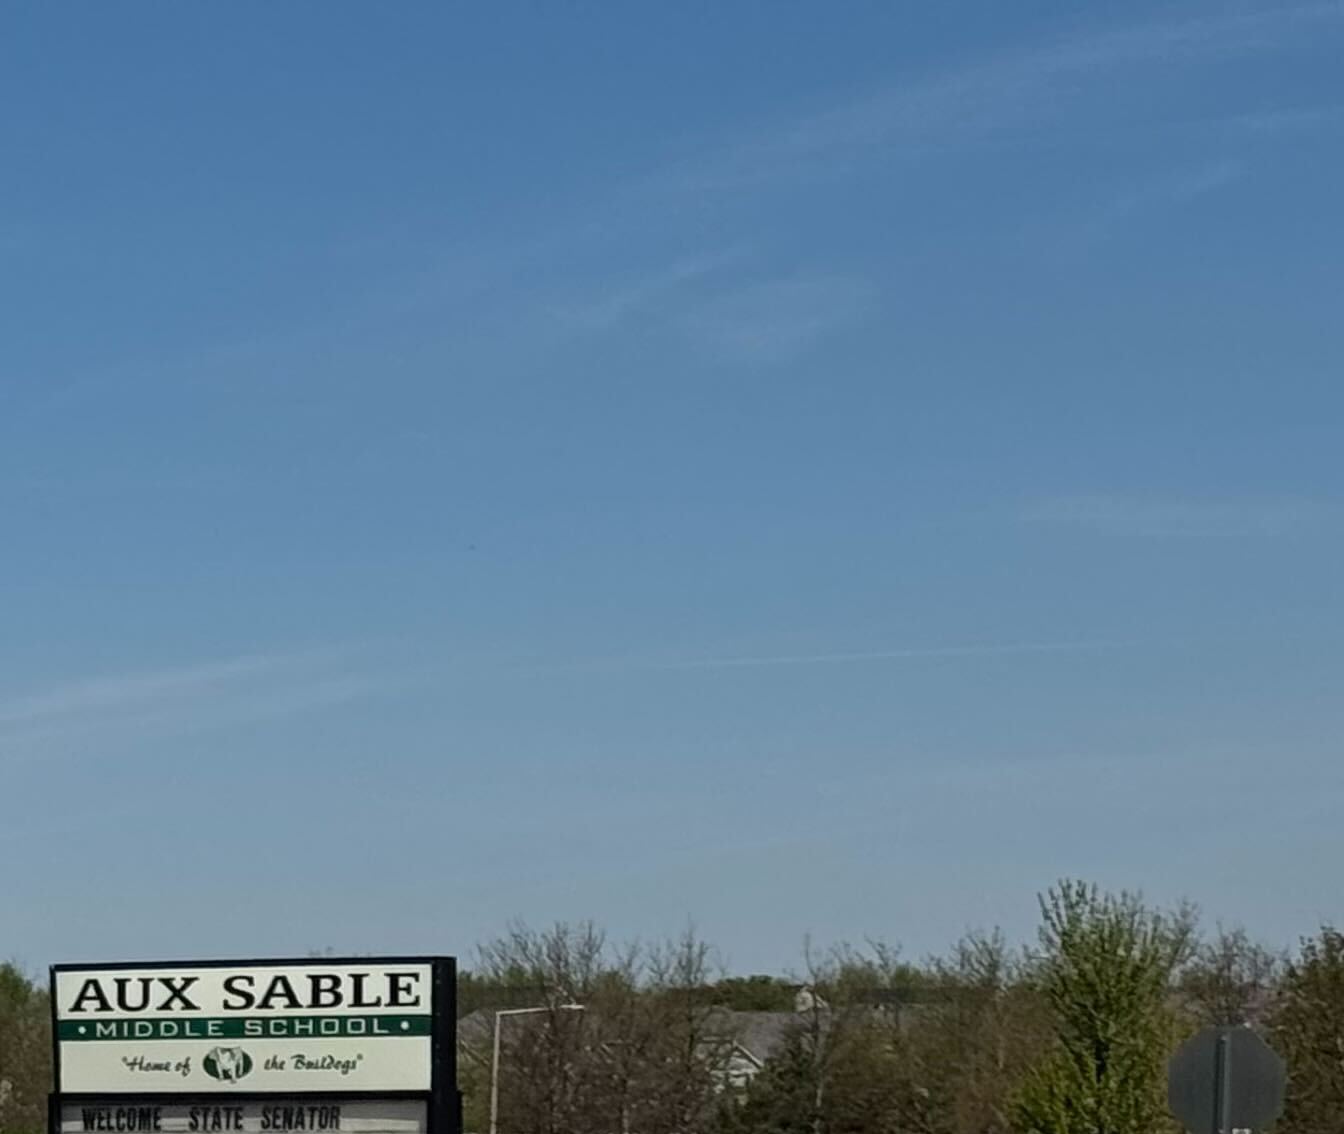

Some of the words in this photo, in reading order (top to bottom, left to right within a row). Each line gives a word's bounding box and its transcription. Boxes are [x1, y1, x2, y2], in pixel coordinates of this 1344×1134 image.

[68, 977, 201, 1012] AUX
[223, 972, 421, 1010] SABLE
[95, 1020, 224, 1038] MIDDLE
[244, 1018, 390, 1036] SCHOOL
[174, 1057, 191, 1077] of
[264, 1055, 286, 1070] the
[81, 1107, 161, 1131] WELCOME
[189, 1106, 244, 1130] STATE
[261, 1105, 341, 1130] SENATOR
